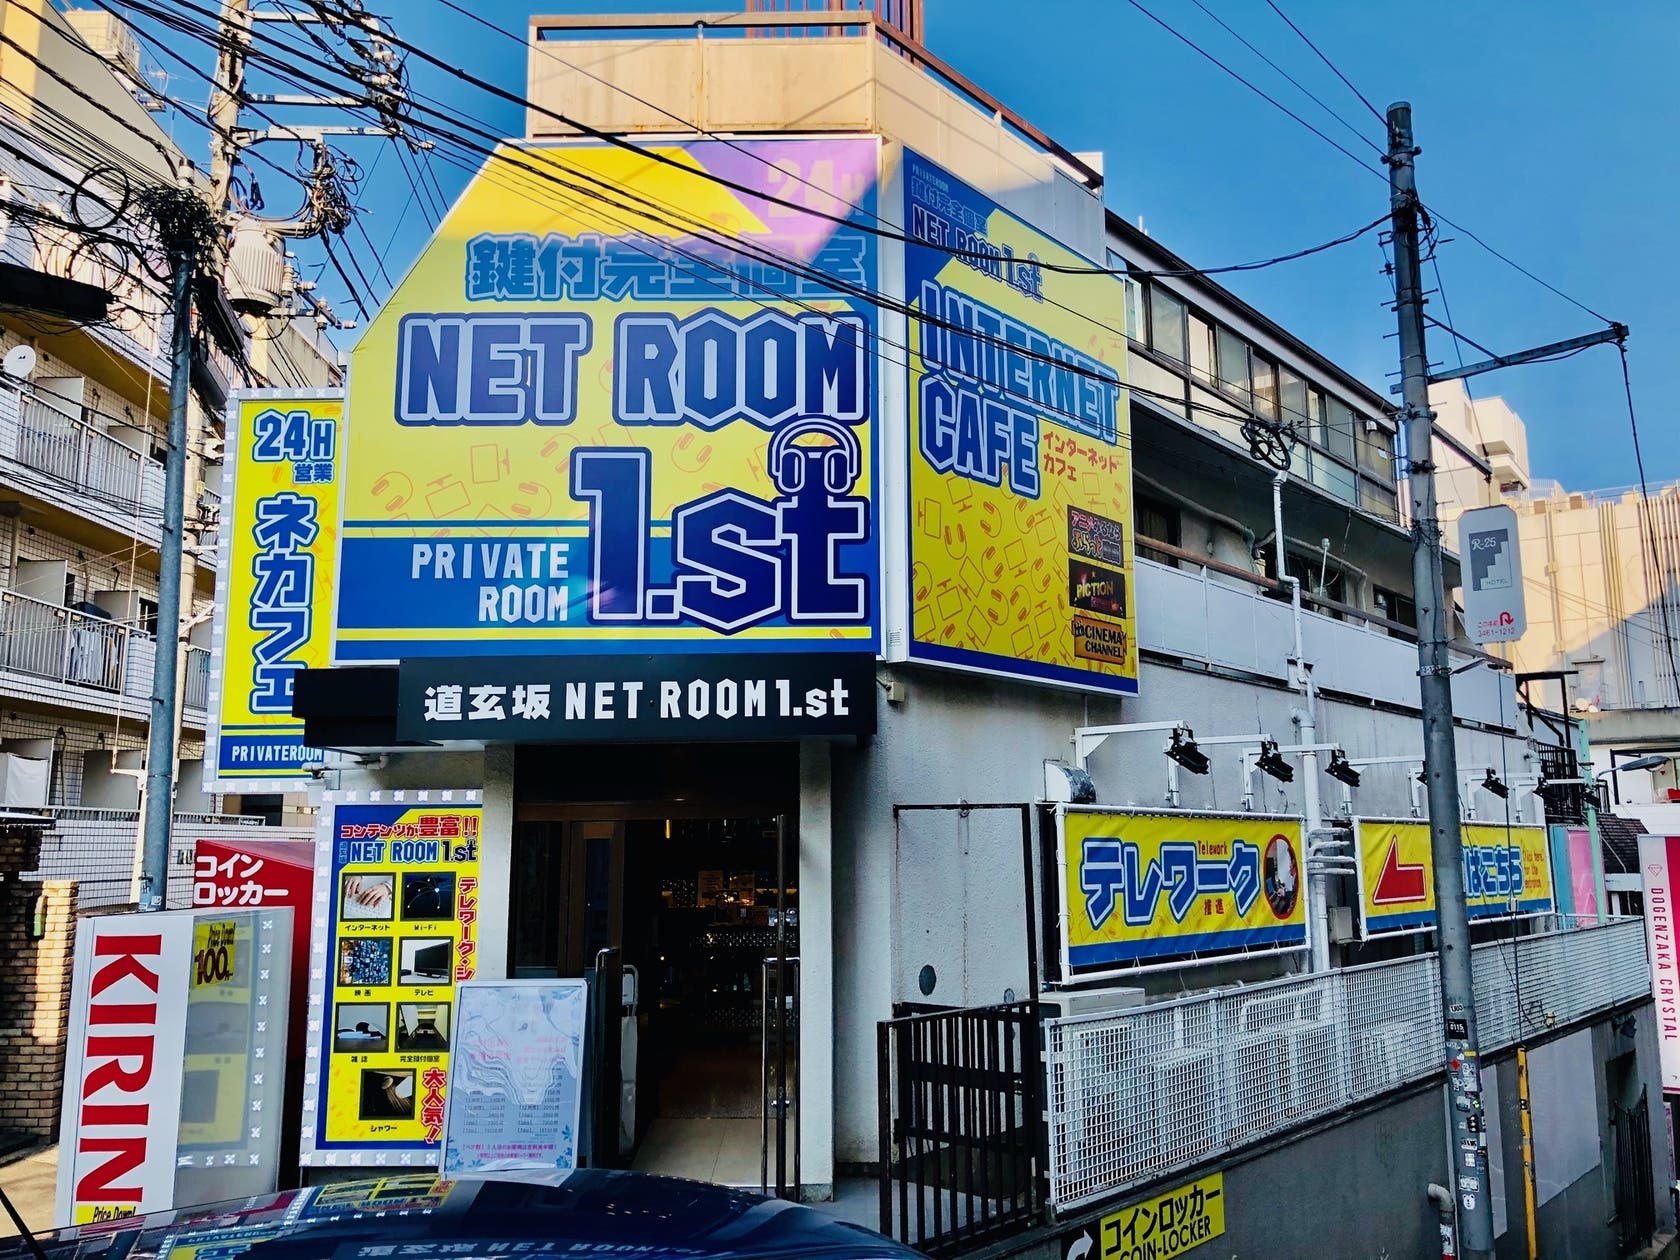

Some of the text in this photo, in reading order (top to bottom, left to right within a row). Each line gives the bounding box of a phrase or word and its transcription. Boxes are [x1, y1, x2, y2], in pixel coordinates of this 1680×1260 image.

[767, 157, 866, 217] 24H
[912, 203, 950, 250] NET
[955, 227, 1003, 284] ROOM
[464, 230, 870, 302] 鍵付完全個室
[395, 307, 870, 431] NET ROOM
[919, 278, 1121, 447] INTERNET
[252, 408, 335, 463] 24H
[919, 372, 1040, 499] CAFE
[1043, 430, 1119, 475] インターネット
[291, 463, 335, 485] 営業
[1043, 453, 1078, 483] カフェ
[569, 446, 871, 636] 1.st
[1471, 537, 1497, 550] R-25
[411, 543, 570, 580] PRIVATE
[248, 494, 320, 716] ネカフェ
[478, 584, 568, 623] ROOM
[1076, 580, 1114, 600] PICTION
[1085, 625, 1122, 645] CINEMA
[1085, 640, 1123, 658] CHANNEL
[424, 684, 551, 722] 道玄坂
[564, 682, 643, 720] NET
[195, 853, 264, 879] コイン
[350, 841, 387, 864] NET
[390, 841, 439, 864] ROOM
[442, 837, 478, 862] 1.st
[1197, 840, 1228, 857] Telework
[1079, 836, 1260, 931] テレワーク
[1461, 845, 1523, 898] はこちら
[193, 880, 289, 906] ロッカー
[345, 923, 390, 932] インターネット
[414, 924, 437, 932] Wi-Fi
[1650, 887, 1678, 1041] DOGENZAKA CRYSTAL
[414, 988, 433, 997] テレビ
[75, 933, 163, 1203] KIRIN
[370, 1124, 397, 1133] シャワー
[1104, 1184, 1221, 1257] コインロッカー
